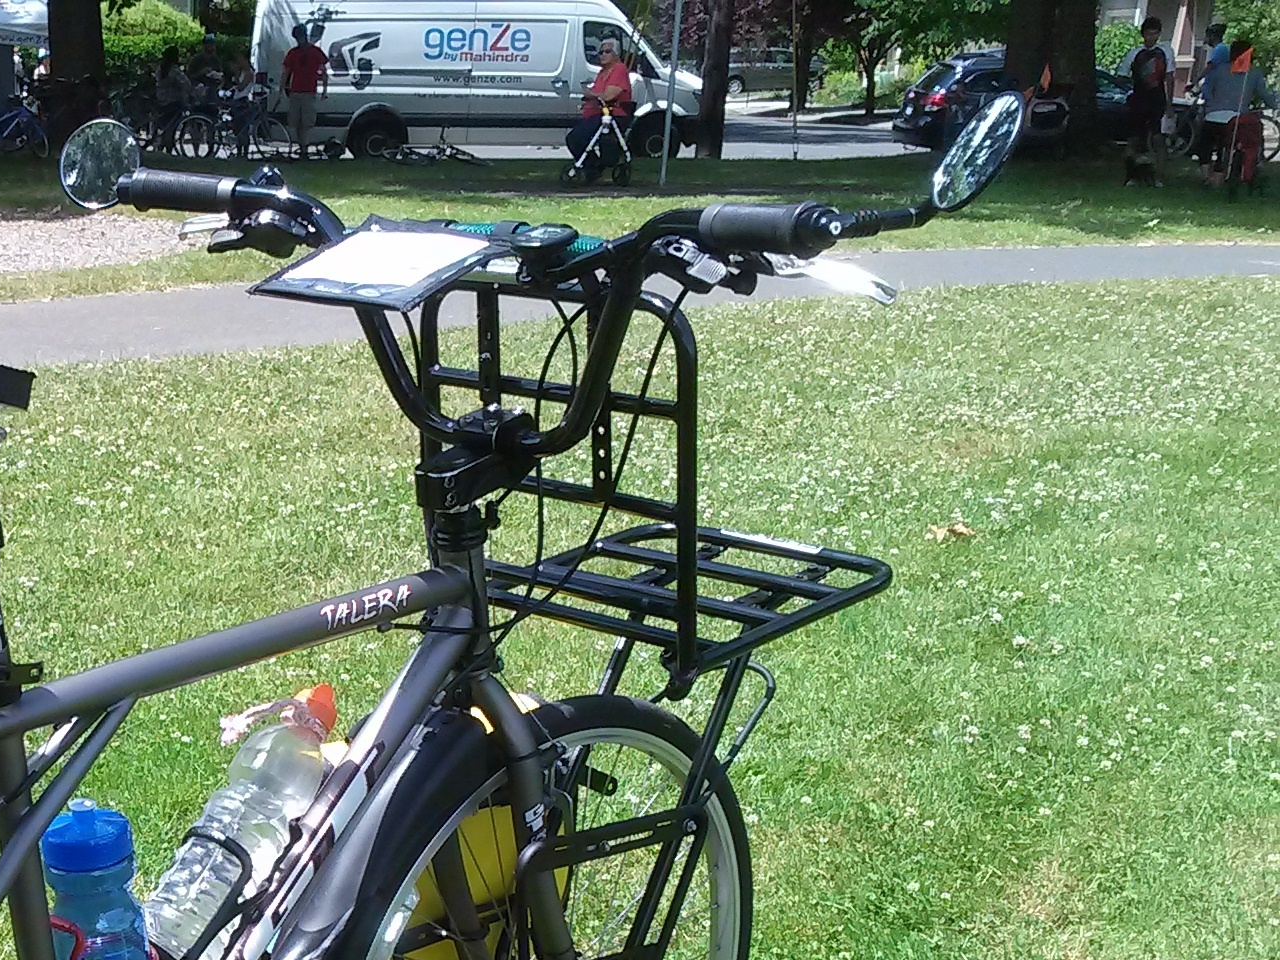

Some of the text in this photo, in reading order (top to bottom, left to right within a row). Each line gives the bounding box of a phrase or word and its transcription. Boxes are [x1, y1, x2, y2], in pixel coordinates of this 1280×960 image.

[423, 23, 531, 60] genZe
[443, 51, 530, 63] by Mahindra
[433, 74, 522, 87] www.genze.com
[320, 583, 414, 632] TALERA
